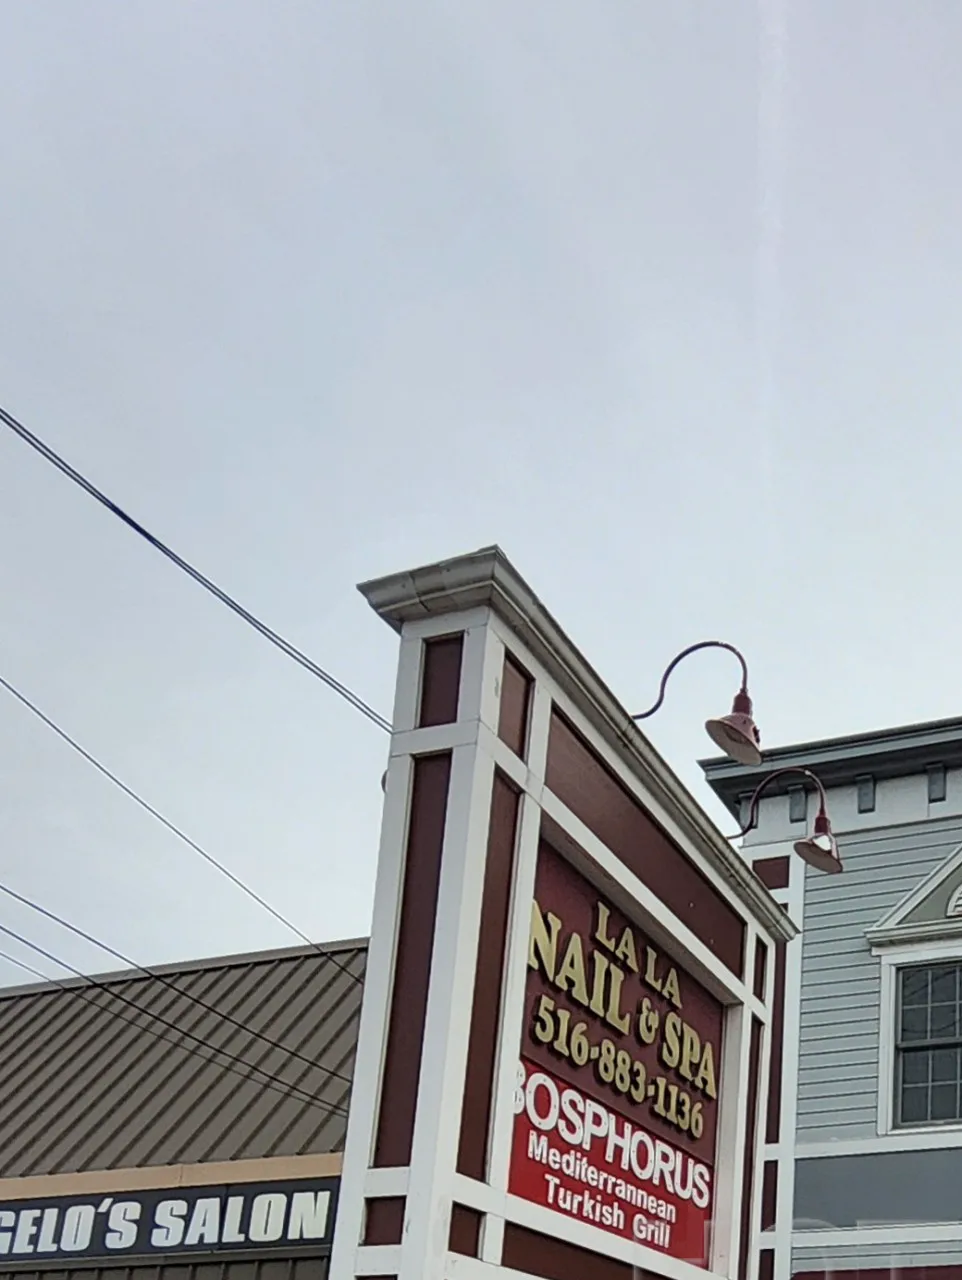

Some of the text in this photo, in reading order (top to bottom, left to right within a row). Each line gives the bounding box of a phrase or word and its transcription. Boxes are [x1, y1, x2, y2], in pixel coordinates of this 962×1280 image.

[528, 899, 717, 1099] NAIL & SPA
[594, 901, 682, 1008] LA LA
[534, 994, 704, 1139] 516-883-1136
[150, 1190, 331, 1247] SALON
[528, 1130, 676, 1223] Mediterrannean
[544, 1174, 670, 1248] Turkish Grill
